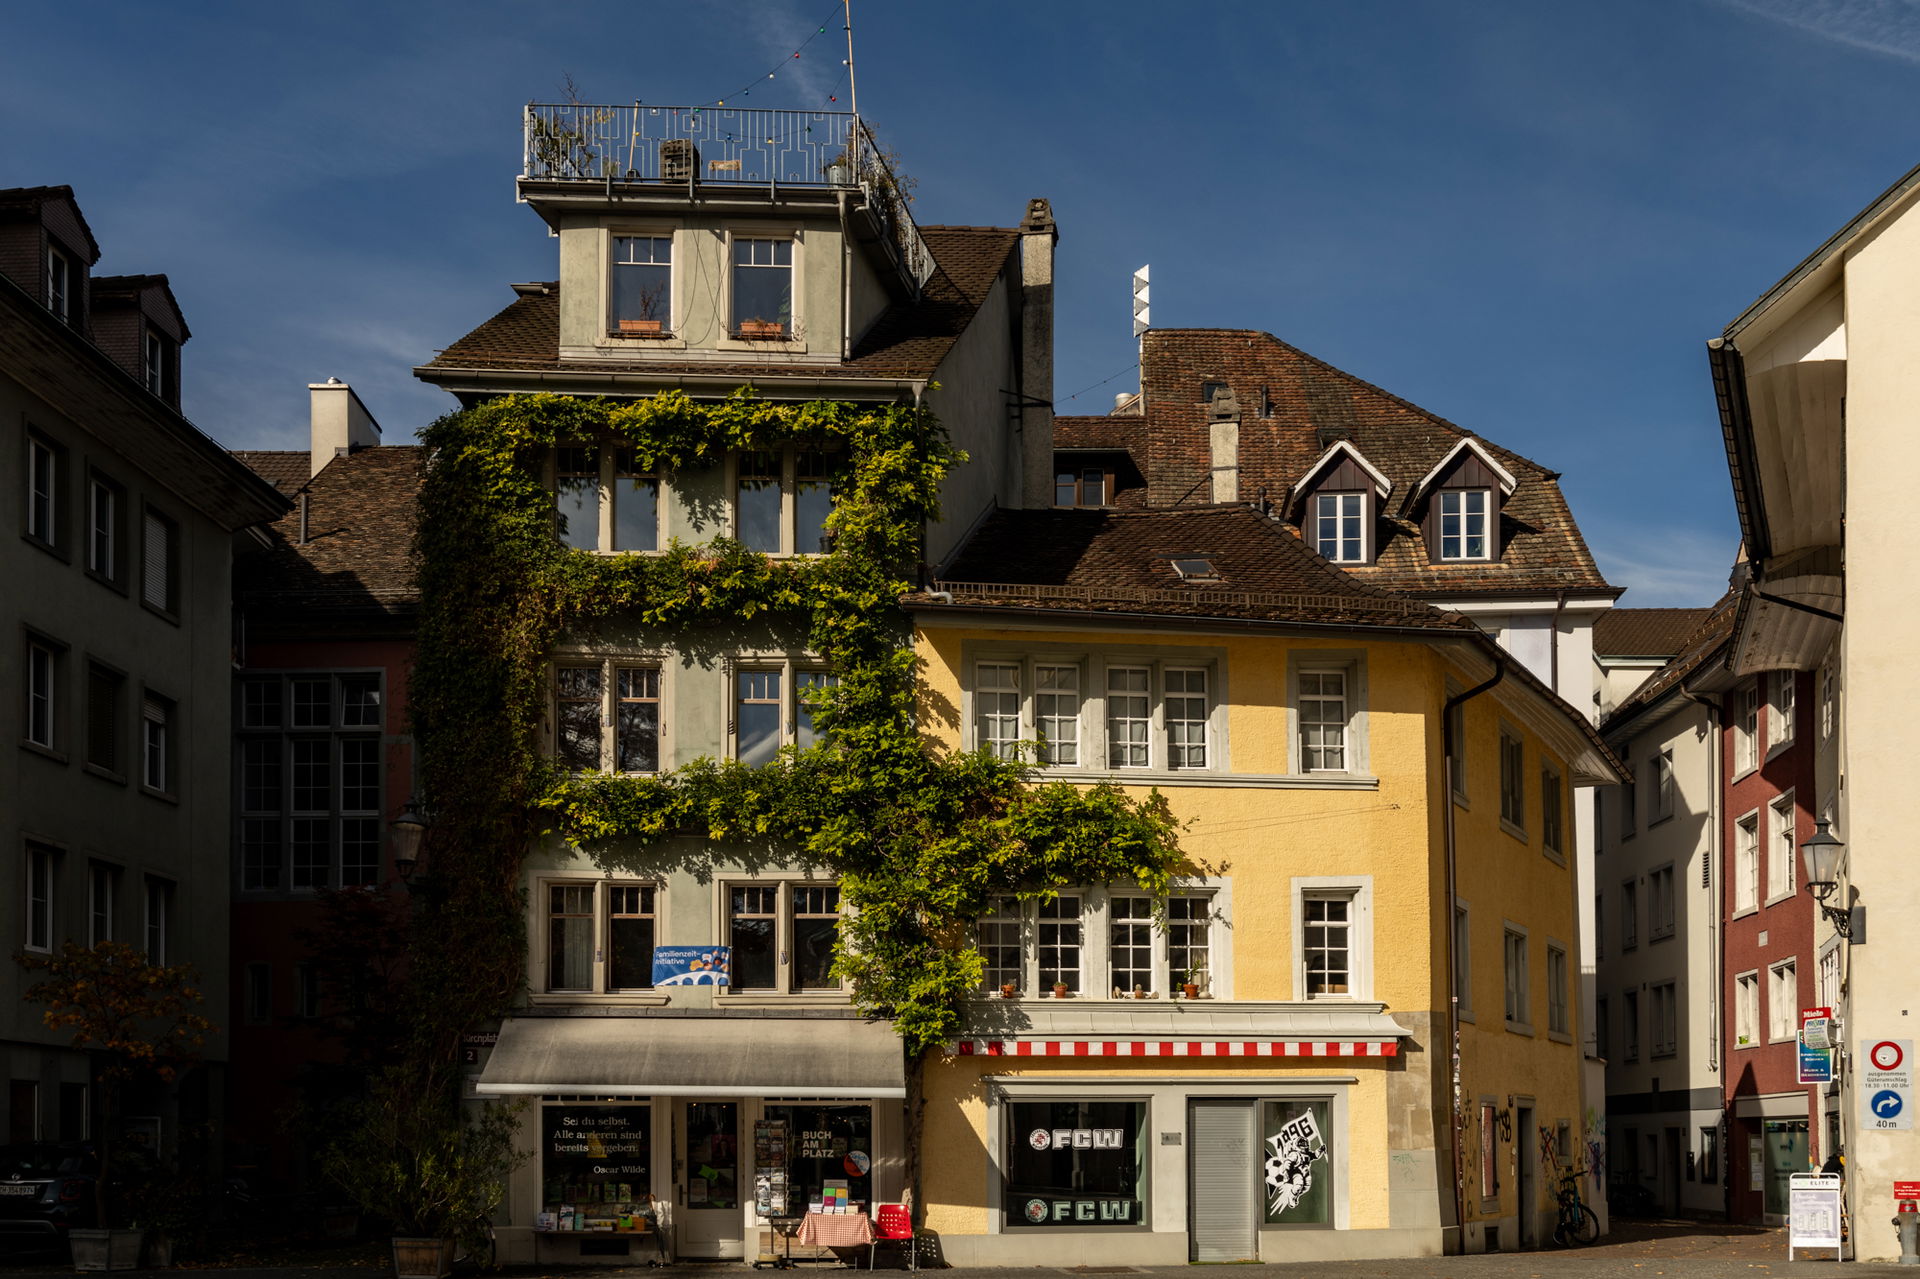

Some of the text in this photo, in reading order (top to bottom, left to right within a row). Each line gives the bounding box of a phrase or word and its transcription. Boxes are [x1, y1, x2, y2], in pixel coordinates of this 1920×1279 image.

[1803, 1010, 1825, 1019] Miele
[466, 1050, 474, 1061] 2
[562, 1116, 631, 1126] Sei du selbst.
[1876, 1120, 1898, 1129] 40 m
[553, 1130, 642, 1139] Alle anderen sind
[802, 1130, 832, 1140] BUCH
[1051, 1128, 1125, 1151] FCW
[554, 1143, 640, 1155] bereits vergeben.
[802, 1140, 820, 1149] AM
[802, 1149, 834, 1159] PLATZ
[592, 1164, 646, 1174] Oscar Wilde
[1051, 1200, 1131, 1221] FCW
